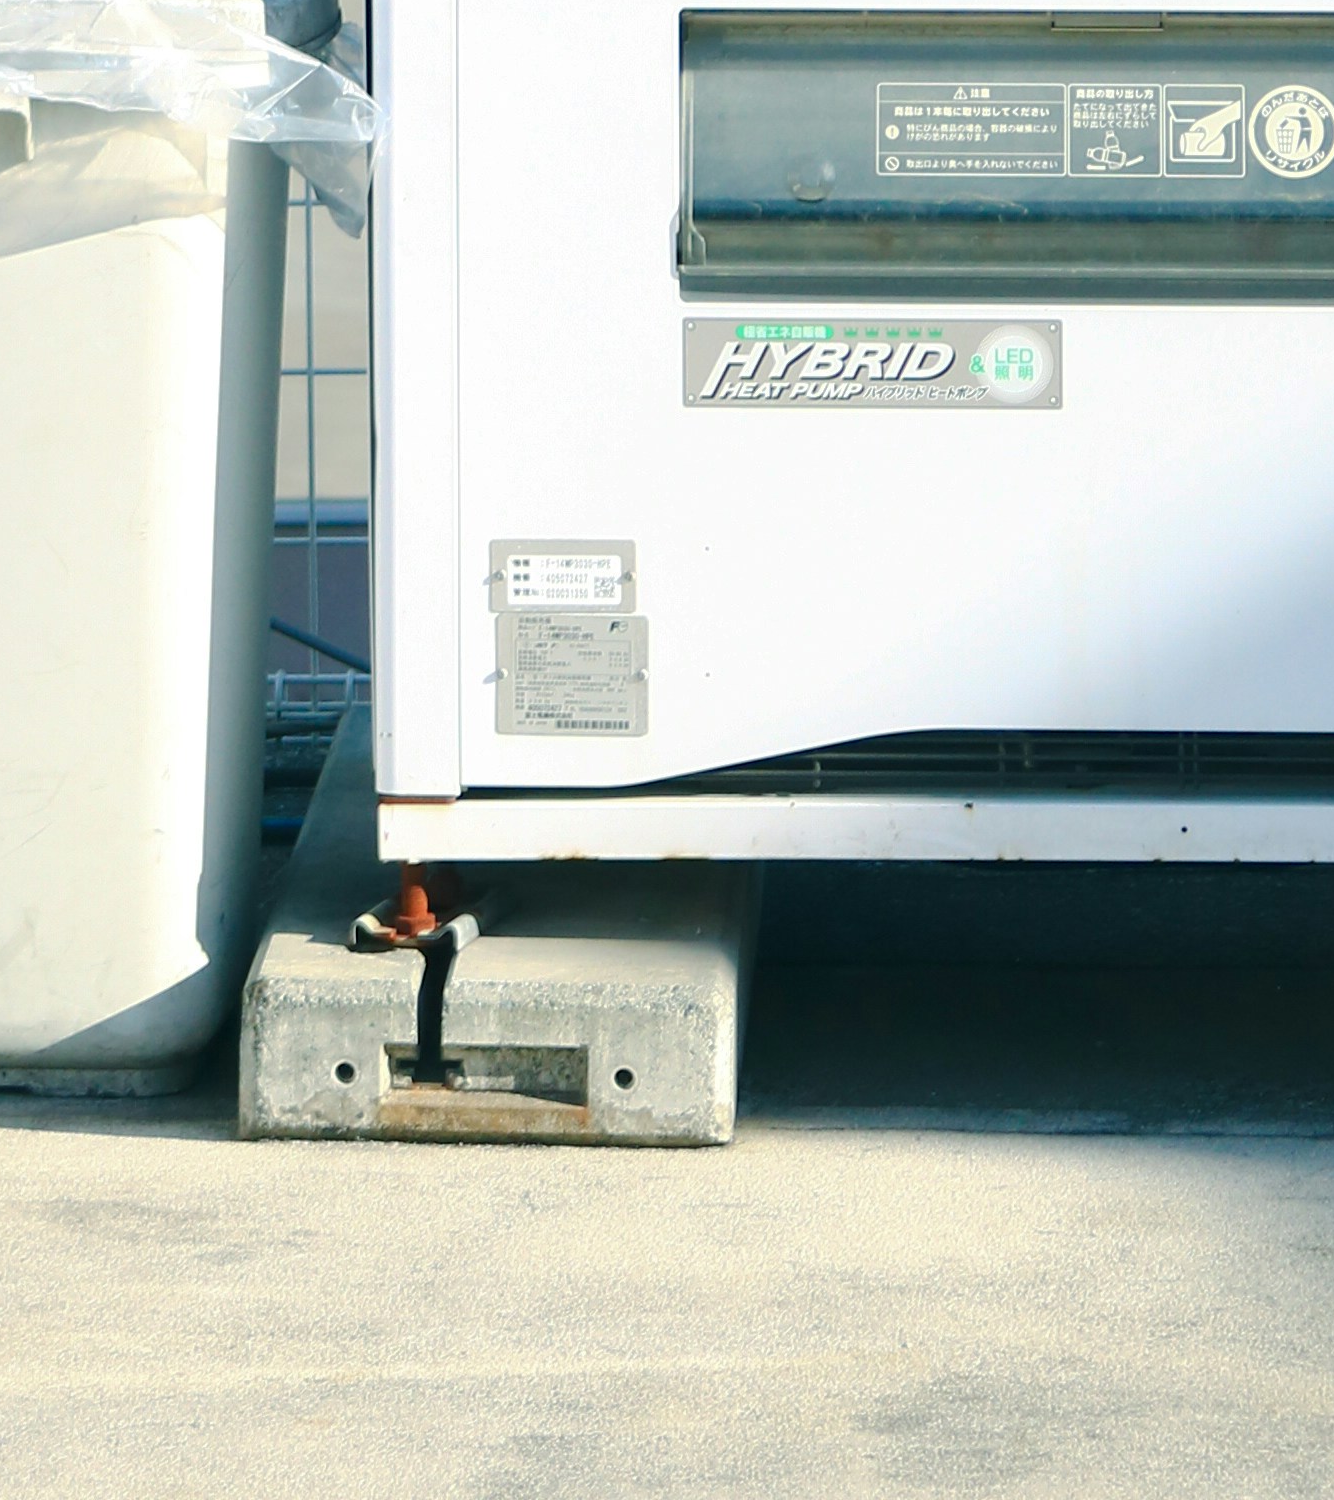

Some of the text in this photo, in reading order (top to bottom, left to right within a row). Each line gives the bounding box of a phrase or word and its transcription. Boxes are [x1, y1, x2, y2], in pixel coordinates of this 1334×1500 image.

[1076, 89, 1154, 99] 商品の取り出し方
[1261, 90, 1329, 119] のんだあとは
[1265, 149, 1326, 171] リサイクル
[700, 342, 956, 398] HYBRID
[995, 349, 1033, 364] LED
[995, 366, 1034, 380] 照明
[723, 382, 864, 400] HEAT PUMP
[866, 386, 988, 400] ハイブリッド ヒートポンプ
